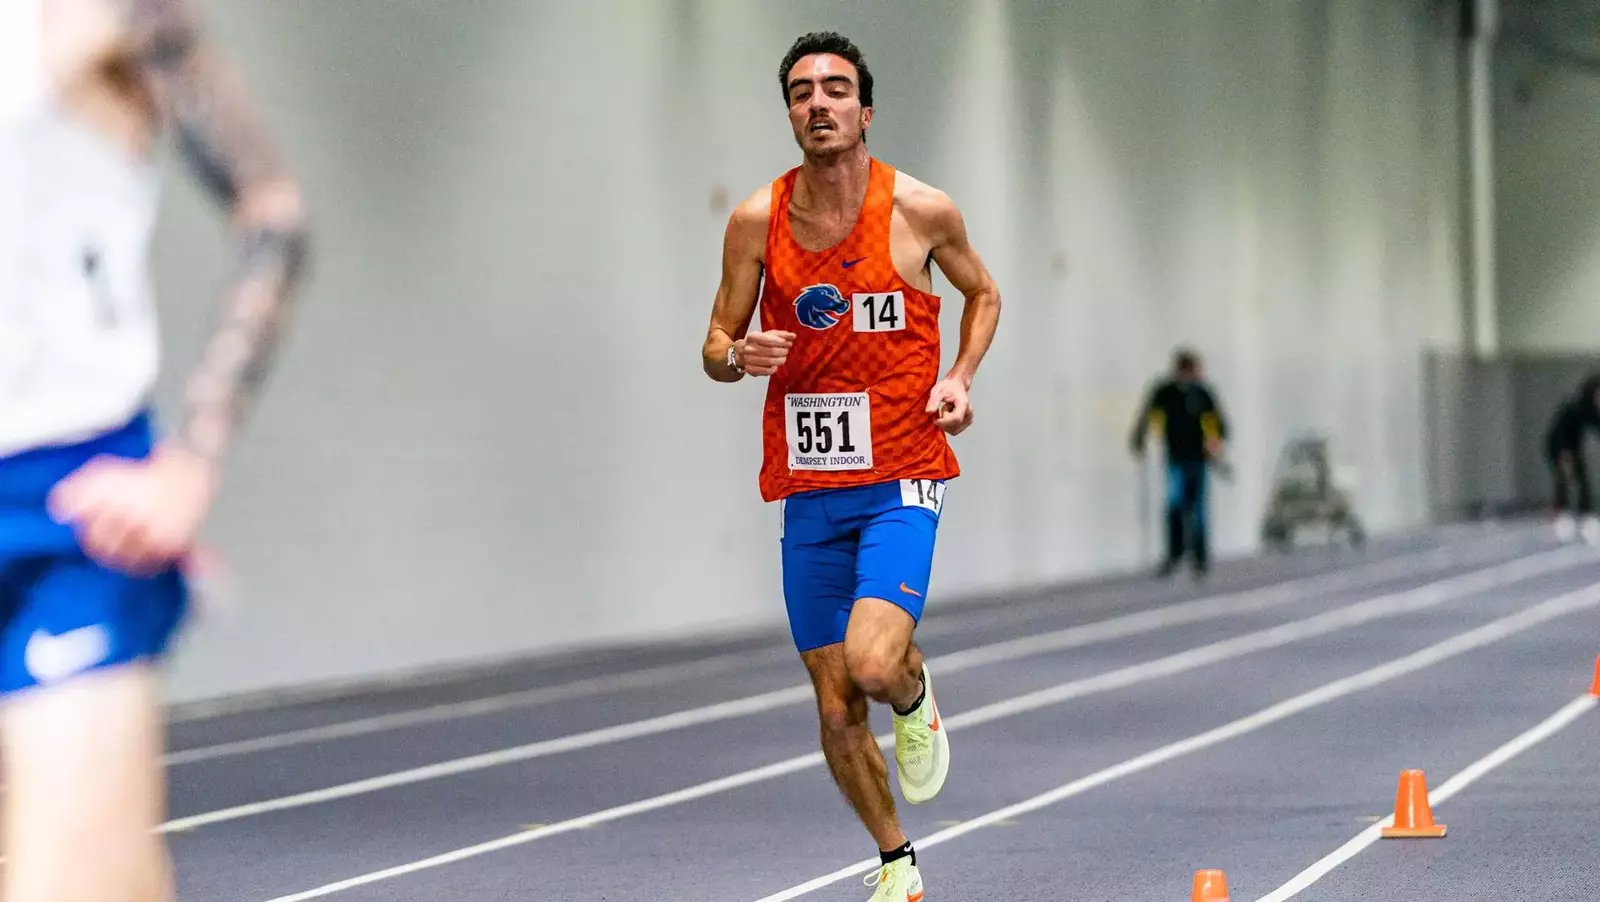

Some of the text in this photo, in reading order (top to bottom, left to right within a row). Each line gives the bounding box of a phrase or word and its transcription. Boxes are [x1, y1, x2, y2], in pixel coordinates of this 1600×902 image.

[862, 295, 898, 329] 14
[790, 396, 861, 407] WASHINGTON
[797, 411, 855, 453] 551
[795, 456, 866, 465] DEMPSEY INDOOR
[910, 479, 938, 509] 14
